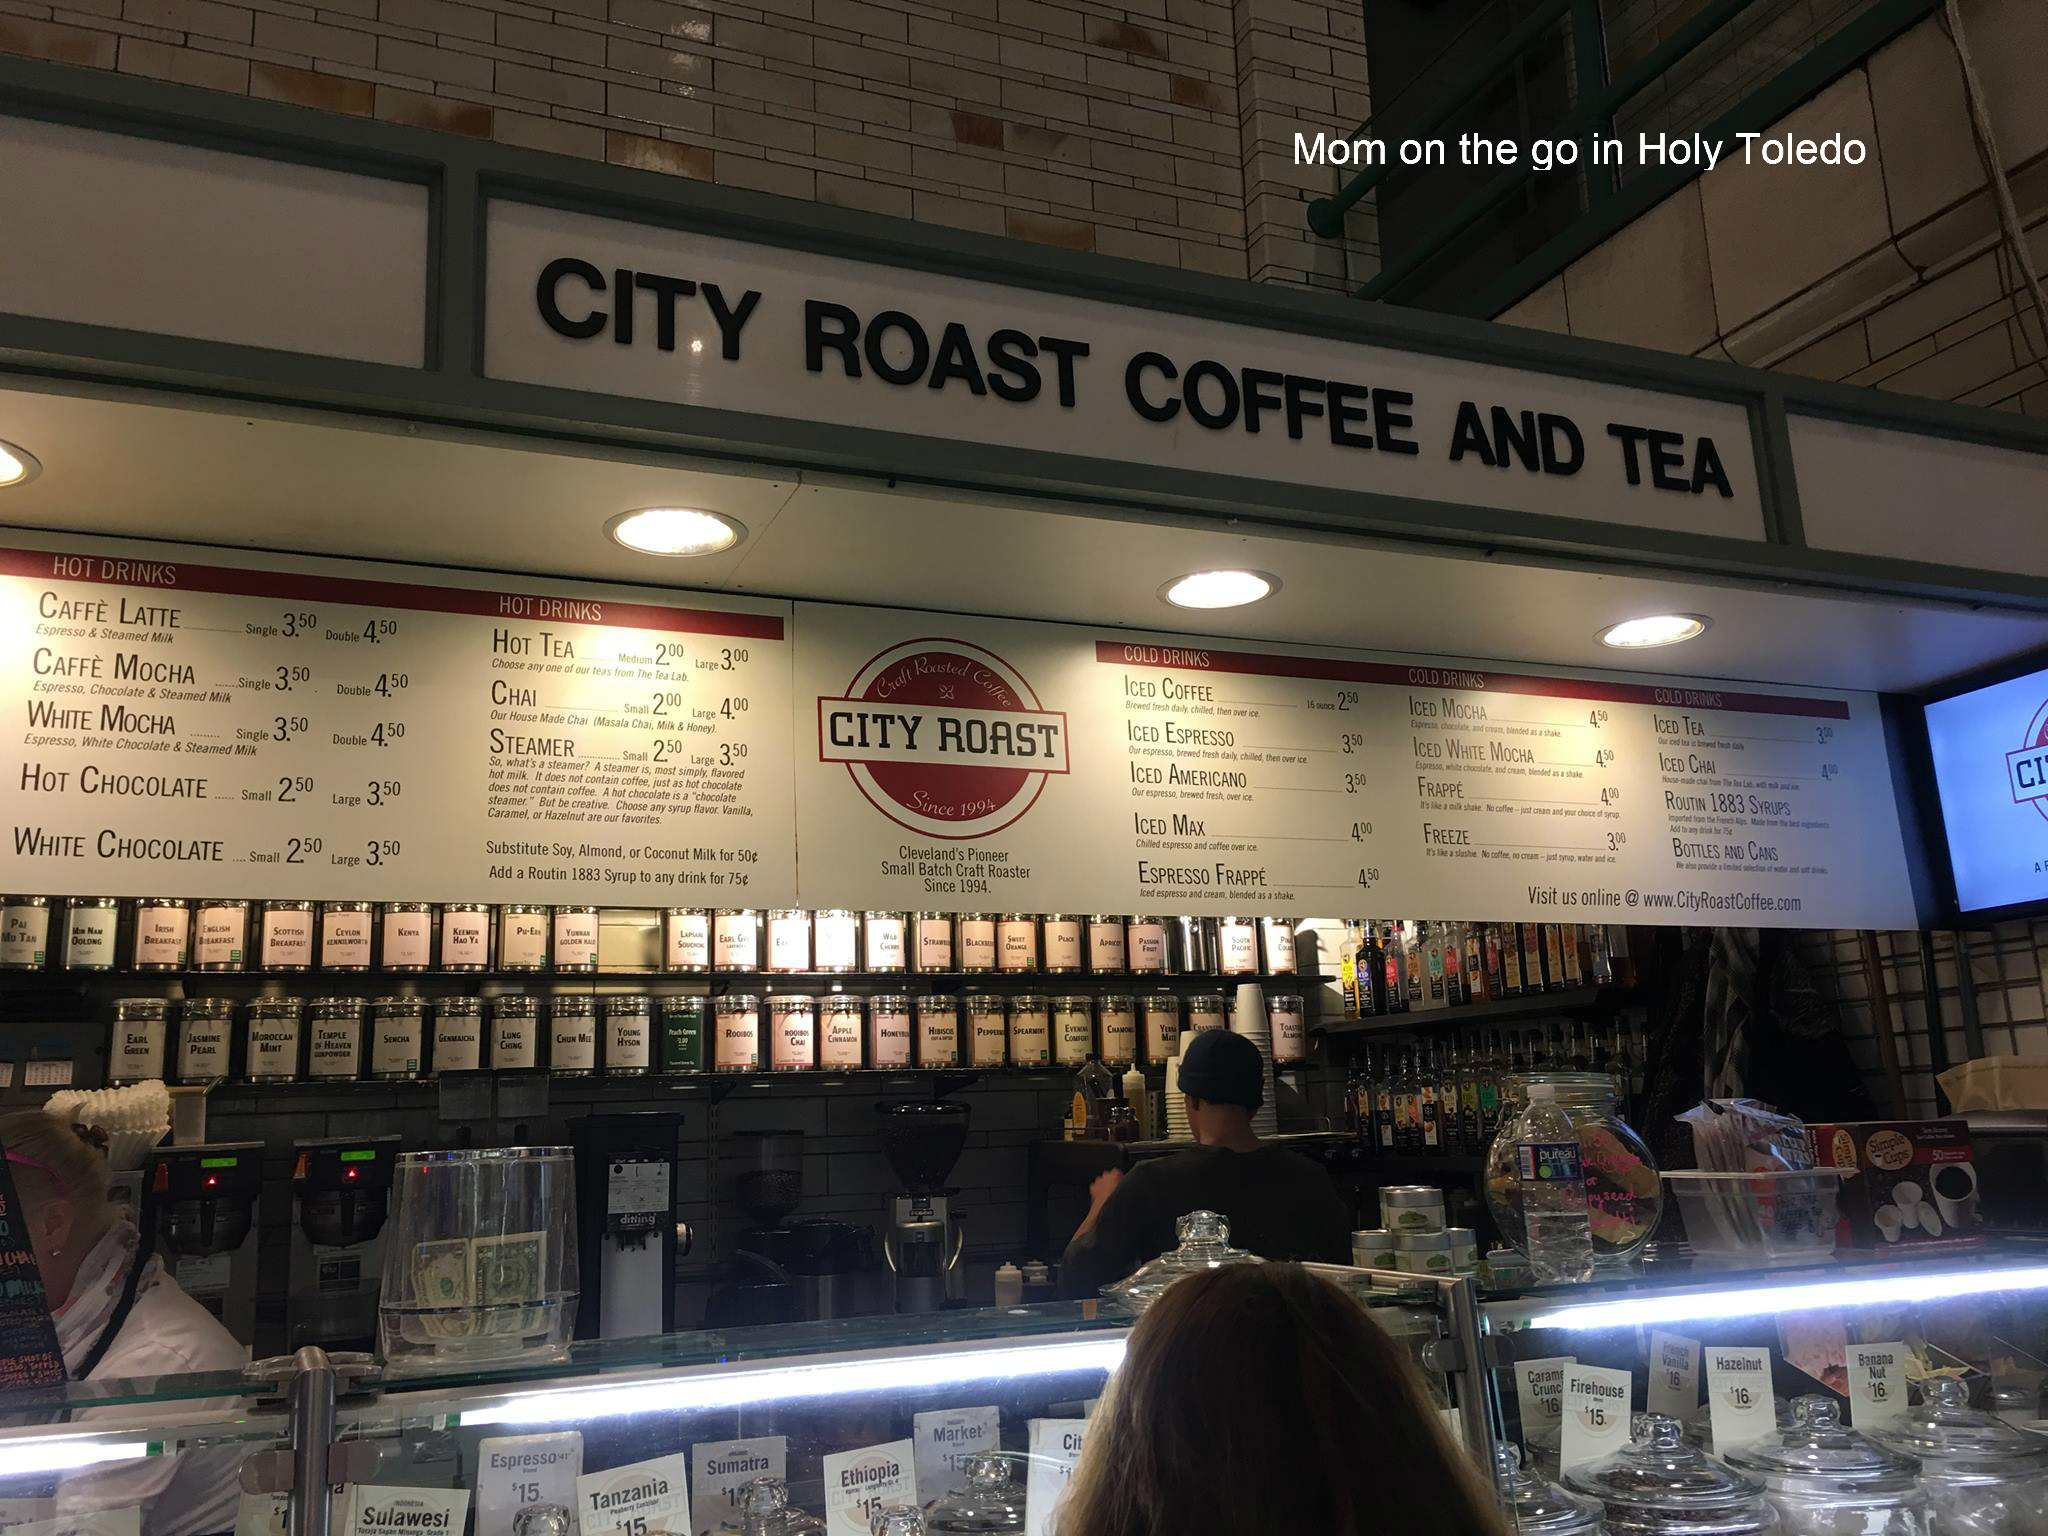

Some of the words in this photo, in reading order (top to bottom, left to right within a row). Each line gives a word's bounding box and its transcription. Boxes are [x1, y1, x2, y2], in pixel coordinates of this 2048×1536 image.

[537, 258, 762, 360] CITY
[805, 299, 1090, 407] ROAST
[1125, 351, 1419, 455] COFFEE
[1449, 401, 1585, 476] AND
[1607, 423, 1734, 497] TEA
[53, 556, 95, 578] HOT
[102, 560, 177, 584] DRINKS
[39, 591, 108, 622] CAFFÈ
[120, 598, 181, 628] LATTE
[246, 624, 278, 637] Single
[282, 613, 317, 637] 3.50
[326, 631, 360, 643] Double
[363, 620, 397, 643] 4.50
[500, 596, 533, 615] HOT
[540, 599, 601, 621] DRINKS
[35, 624, 86, 639] Espresso
[87, 628, 98, 638] &
[100, 628, 149, 643] Steamed
[151, 631, 174, 644] Milk
[493, 629, 532, 655] HOT
[540, 633, 574, 658] TEA
[618, 653, 653, 665] Medium
[656, 644, 684, 665] 2.00
[695, 659, 719, 671] Large
[721, 649, 749, 671] 3.00
[1124, 645, 1158, 663] COLD
[1163, 648, 1210, 668] DRINKS
[33, 648, 103, 679] CAFFÈ
[114, 653, 196, 685] MOCHA
[239, 678, 271, 691] Single
[275, 667, 310, 691] 3.50
[337, 684, 371, 696] Double
[375, 674, 408, 697] 4.50
[877, 669, 912, 698] Craft
[914, 656, 972, 677] Roasted
[973, 670, 1012, 708] Coffee
[1125, 674, 1156, 698] ICED
[1162, 677, 1214, 702] COFFEE
[1307, 699, 1315, 708] 16
[1316, 701, 1335, 710] ounce
[1337, 691, 1358, 711] 2.50
[28, 700, 93, 731] WHITE
[100, 705, 175, 735] MOCHA
[236, 729, 269, 742] Single
[273, 717, 308, 741] 3.50
[333, 735, 367, 746] Double
[371, 724, 405, 747] 4.50
[1409, 696, 1437, 717] ICED
[1442, 698, 1487, 720] MOCHA
[1590, 710, 1608, 729] 4.50
[830, 712, 922, 750] CITY
[937, 717, 1058, 758] ROAST
[490, 728, 575, 757] STEAMER
[623, 751, 648, 761] Small
[653, 740, 682, 763] 2.50
[691, 755, 714, 766] Large
[720, 743, 748, 766] 3.50
[1413, 736, 1441, 757] ICED
[1446, 739, 1485, 761] WHITE
[1490, 741, 1534, 764] MOCHA
[1596, 750, 1614, 768] 4.50
[1130, 761, 1162, 784] ICED
[1169, 763, 1247, 788] AMERICANO
[1346, 773, 1366, 793] 3.50
[1418, 776, 1464, 798] FRAPPÉ
[1601, 788, 1619, 806] 4.00
[906, 790, 954, 816] Since
[960, 799, 996, 816] 1994
[1665, 790, 1706, 812] ROUTIN
[1711, 792, 1745, 814] 1883
[1750, 795, 1791, 816] SYRUPS
[1135, 812, 1167, 835] ICED
[1173, 814, 1206, 837] MAX
[1352, 822, 1372, 842] 4.00
[1424, 823, 1470, 845] FREEZE
[1607, 832, 1626, 851] 3.00
[14, 827, 86, 858] WHITE
[97, 830, 224, 862] CHOCOLATE
[249, 851, 280, 863] Small
[286, 838, 322, 863] 2.50
[331, 855, 360, 867] Large
[366, 841, 400, 865] 3.50
[486, 840, 549, 856] Substitute
[552, 843, 575, 859] Soy,
[579, 844, 626, 859] Almond,
[629, 847, 640, 858] or
[644, 846, 689, 860] Coconut
[693, 847, 716, 861] Milk
[720, 848, 734, 861] for
[899, 846, 964, 861] Cleveland's
[968, 848, 1008, 862] Pioneer
[1672, 837, 1720, 859] BOTTLES
[1724, 845, 1744, 860] AND
[1748, 841, 1779, 861] CANS
[881, 861, 915, 876] Small
[919, 863, 952, 877] Batch
[956, 864, 984, 878] Craft
[988, 865, 1030, 879] Roaster
[1138, 861, 1210, 885] ESPRESSO
[1216, 863, 1268, 886] FRAPPÉ
[1358, 868, 1379, 888] 4.50
[924, 879, 956, 892] Since
[960, 880, 992, 893] 1994.
[1528, 886, 1557, 905] Visit
[1562, 892, 1577, 905] us
[1582, 889, 1621, 907] online
[1625, 889, 1639, 906] @
[1643, 890, 1801, 912] www.CityRoastCoffee.com
[398, 928, 419, 937] KENYA
[453, 936, 467, 944] HAO
[469, 937, 479, 945] YA
[127, 1034, 148, 1044] EARL
[187, 1033, 221, 1043] JASMINE
[252, 1032, 293, 1042] MOROCCAN
[384, 1034, 410, 1043] SENCHA
[502, 1031, 521, 1040] LUNG
[617, 1028, 641, 1037] YOUNG
[617, 1037, 640, 1047] HYSON
[726, 1029, 753, 1038] ROOIBOS
[124, 1045, 149, 1055] GREEN
[190, 1045, 216, 1055] PEARL
[260, 1043, 282, 1053] MINT
[500, 1040, 522, 1049] CHING
[1716, 1356, 1762, 1372] Hazelnut
[1858, 1352, 1894, 1366] Banana
[1869, 1365, 1886, 1380] Nut
[1570, 1377, 1625, 1399] Firehouse
[934, 1426, 982, 1443] Market
[491, 1452, 557, 1469] Espresso
[706, 1455, 769, 1475] Sumatra
[841, 1461, 901, 1488] Ethiopia
[590, 1478, 669, 1512] Tanzania
[362, 1507, 450, 1527] Sulawesi
